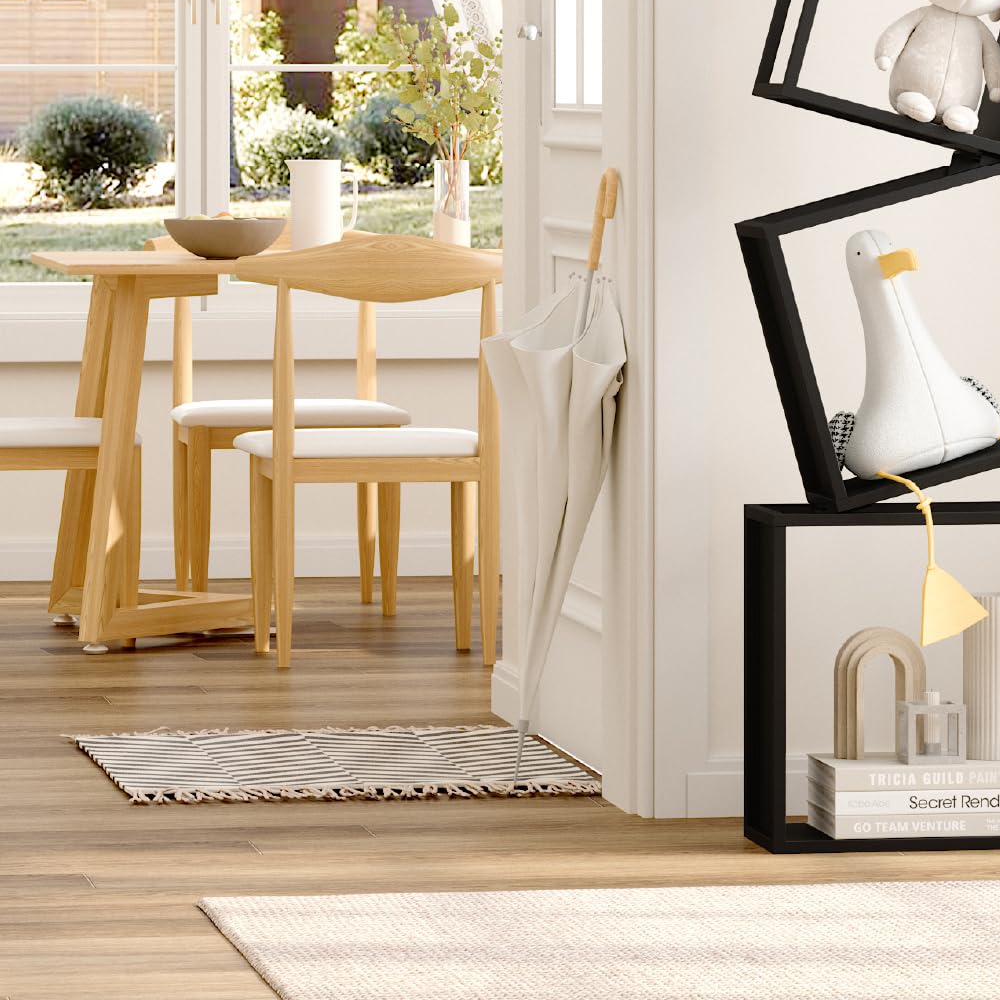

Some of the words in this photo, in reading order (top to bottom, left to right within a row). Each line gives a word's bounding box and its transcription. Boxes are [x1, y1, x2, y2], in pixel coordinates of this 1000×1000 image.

[869, 772, 917, 786] TRICIA
[922, 771, 965, 785] GUILD
[908, 795, 958, 809] Secret
[853, 822, 872, 833] GO
[874, 821, 909, 833] TEAM
[911, 820, 967, 832] VENTURE
